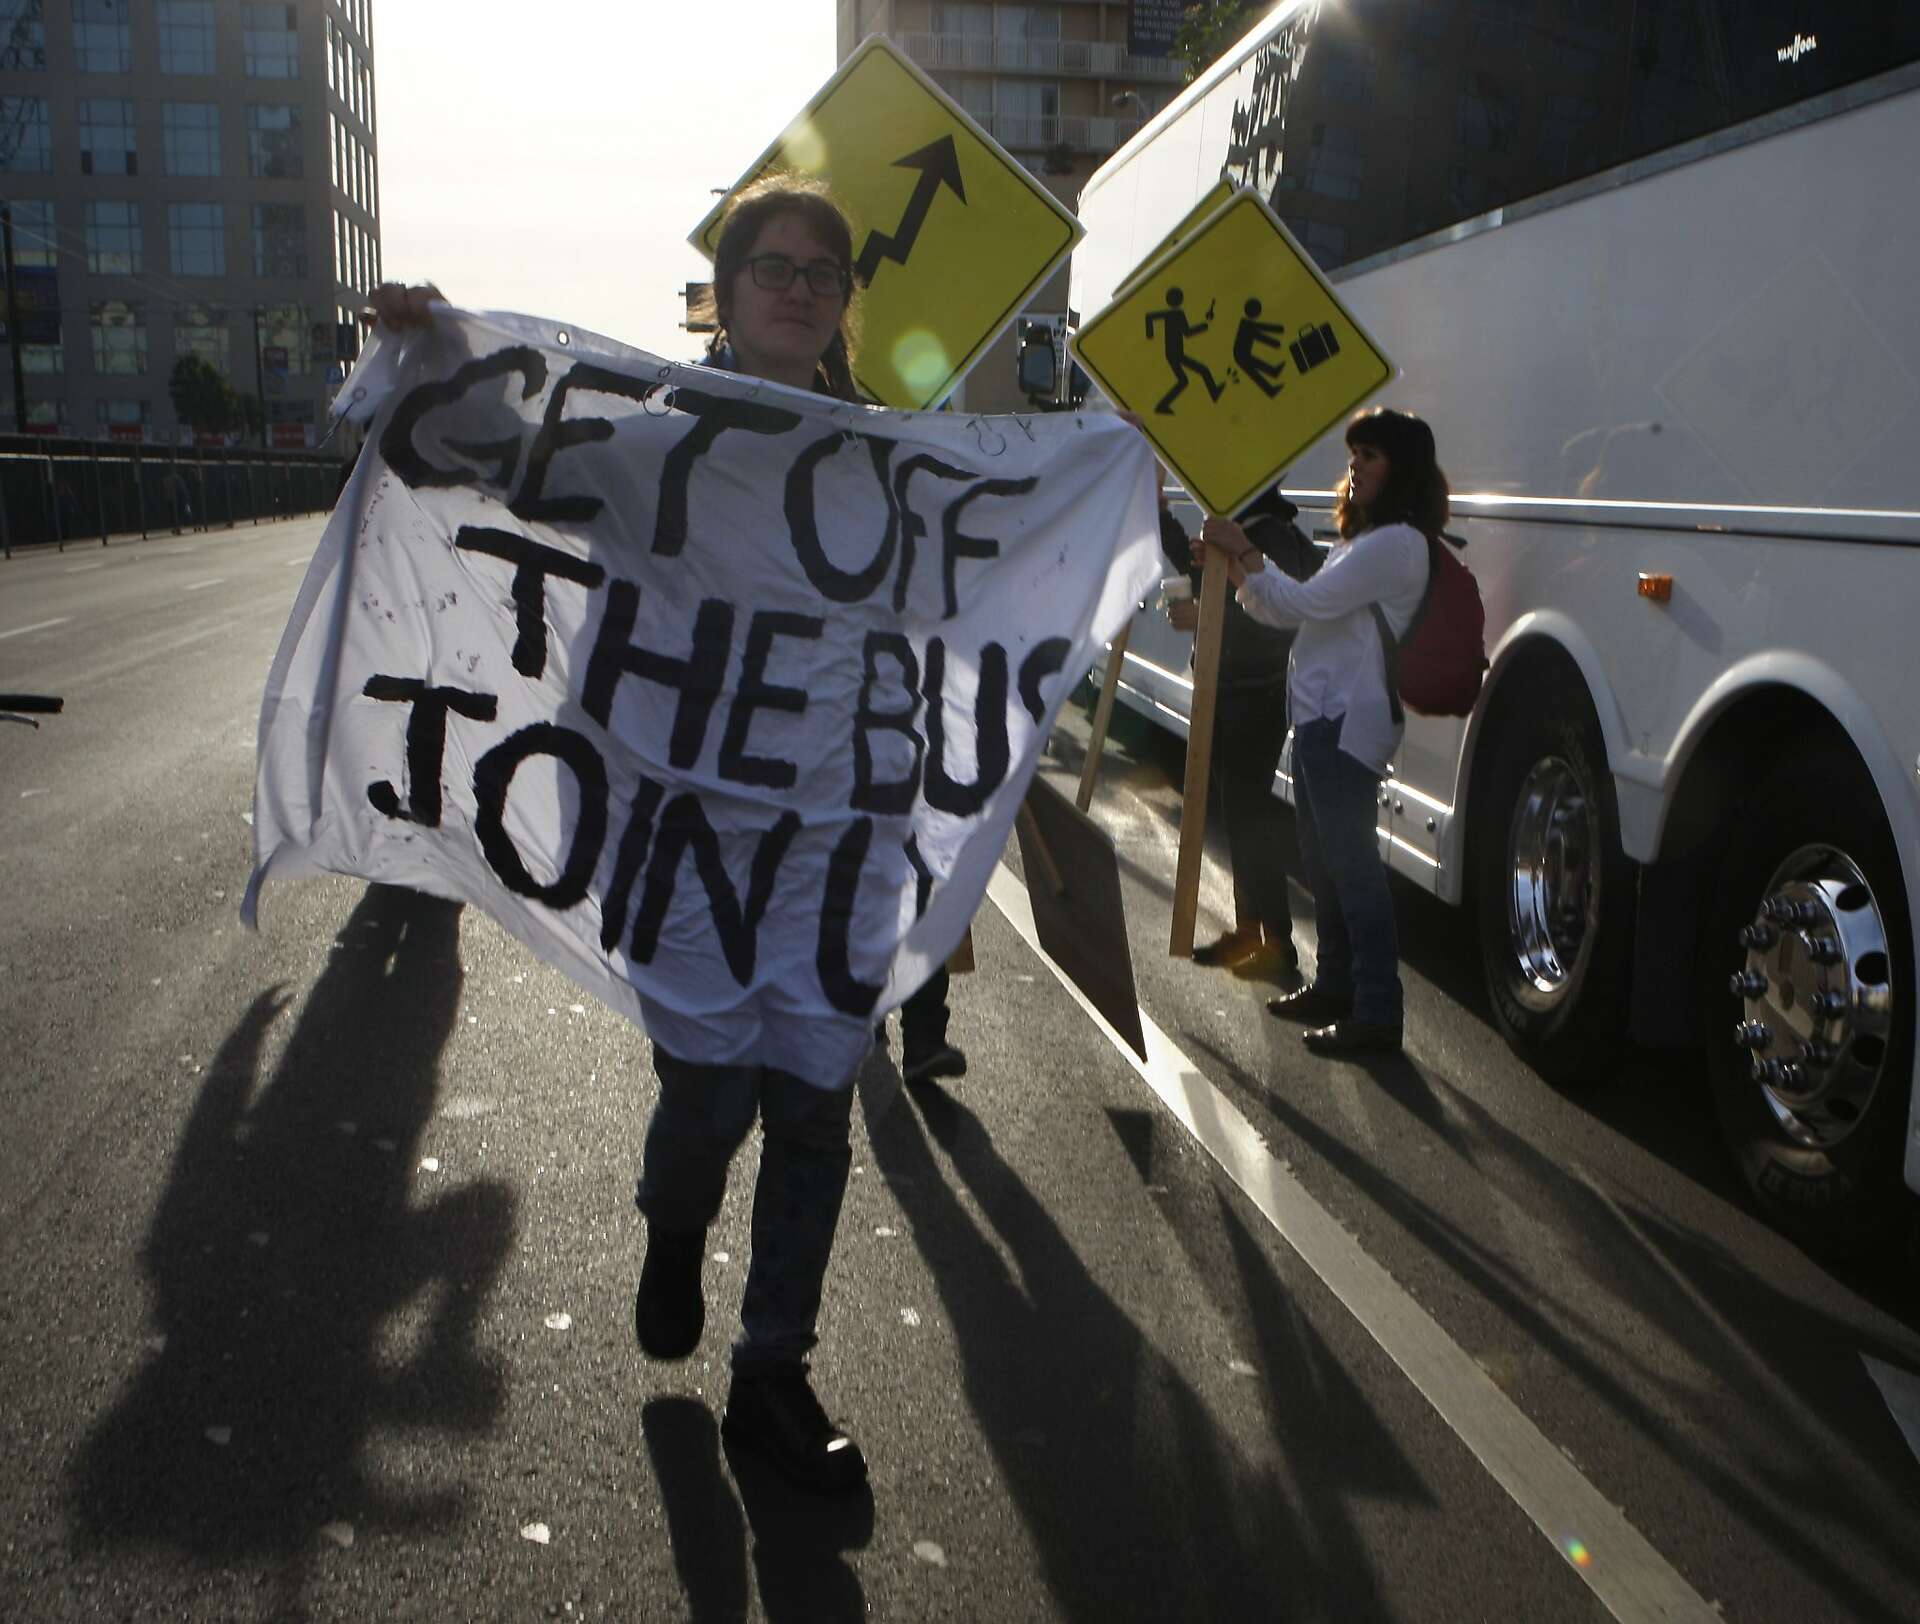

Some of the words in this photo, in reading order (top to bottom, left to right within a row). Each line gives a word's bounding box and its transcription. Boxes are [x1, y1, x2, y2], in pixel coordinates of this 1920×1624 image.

[378, 345, 802, 556] GET
[783, 424, 1038, 619] OFF
[455, 525, 822, 788] THE
[363, 673, 801, 987] JOIN
